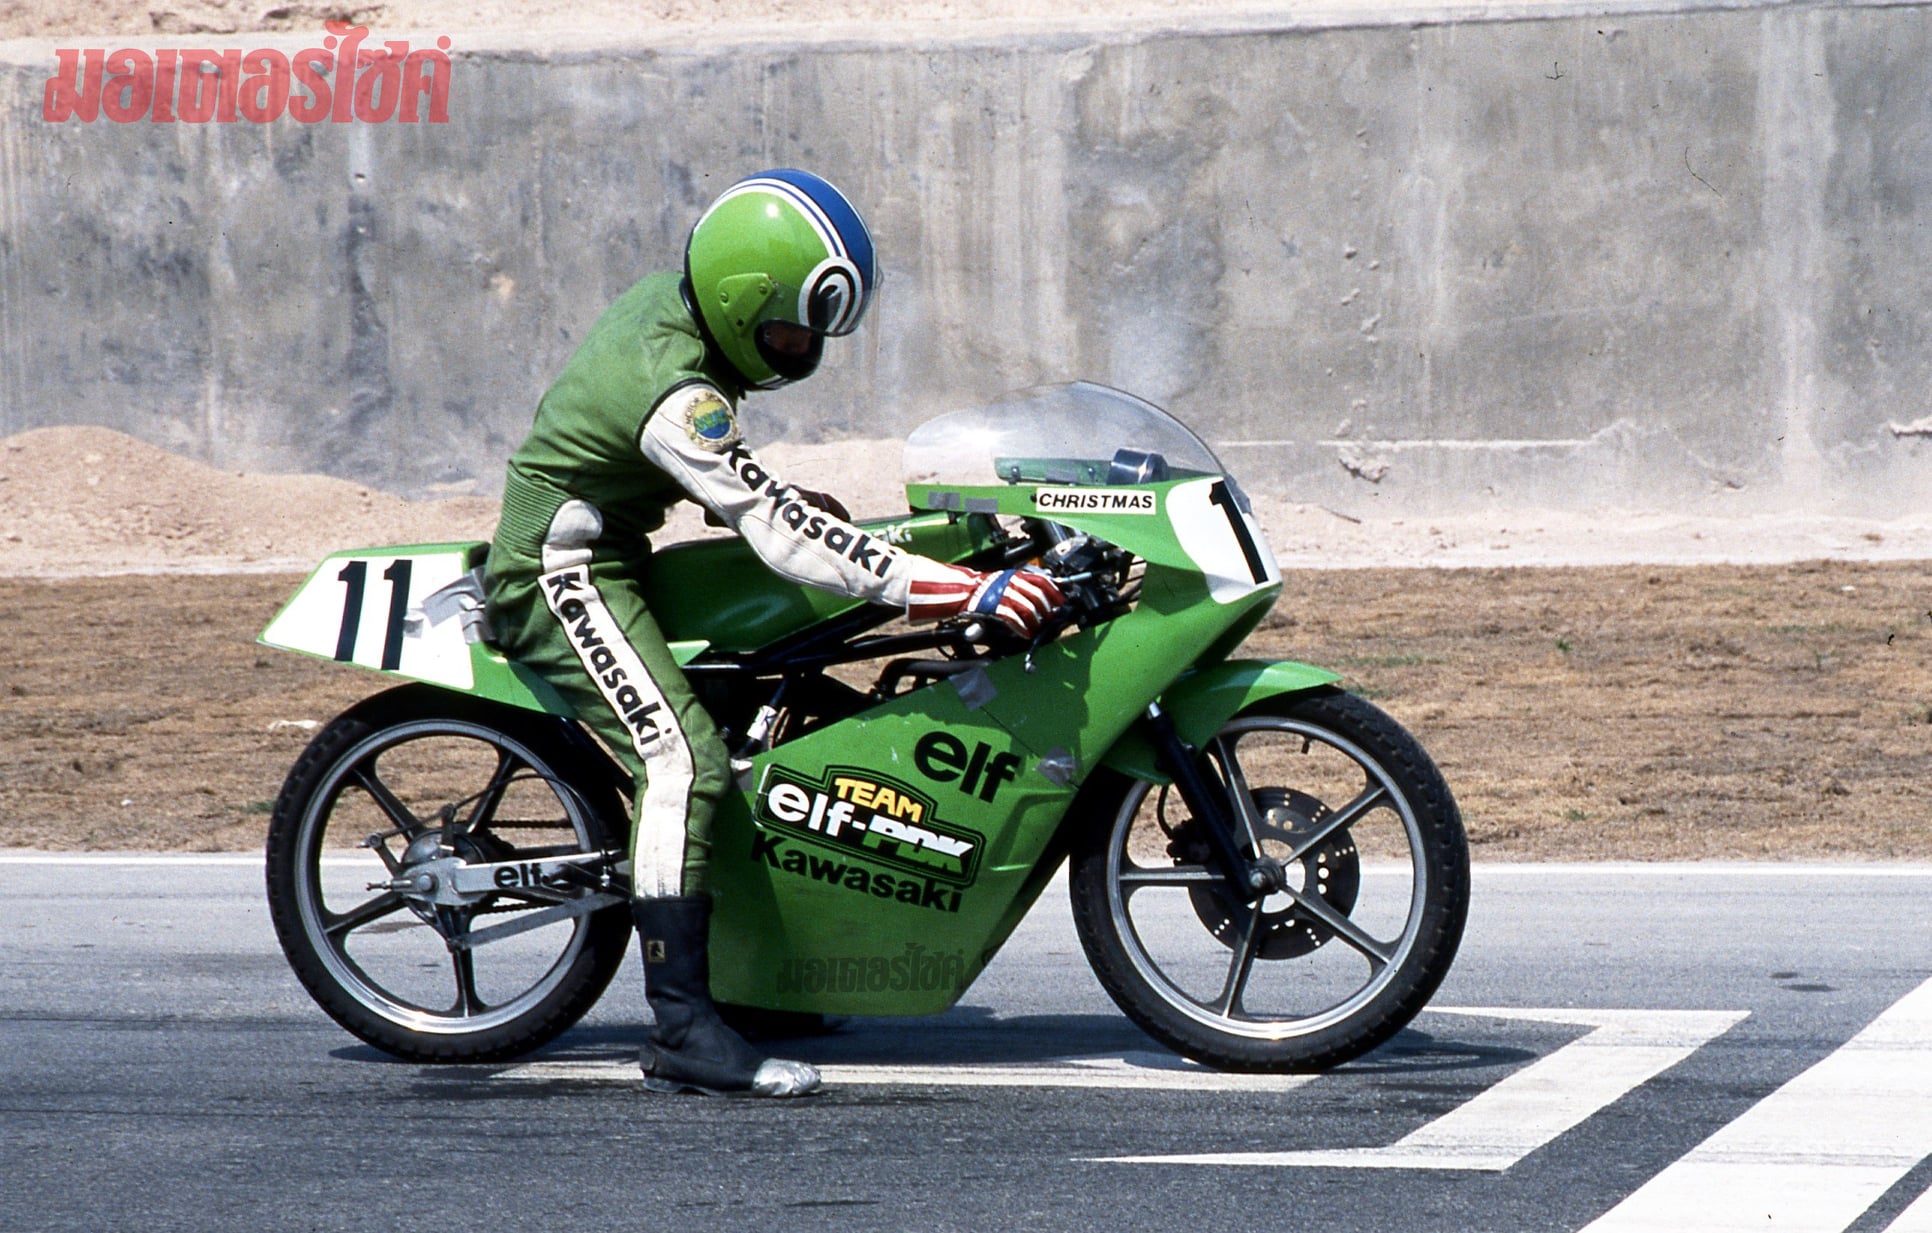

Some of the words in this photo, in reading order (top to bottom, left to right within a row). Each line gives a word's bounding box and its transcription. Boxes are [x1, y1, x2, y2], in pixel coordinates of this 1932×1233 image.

[1038, 492, 1153, 510] CHRISTMAS
[334, 559, 413, 671] 11
[547, 572, 672, 745] Kawasaki
[834, 777, 923, 823] TEAM
[914, 731, 1020, 803] elf
[494, 863, 543, 889] elf
[752, 831, 963, 913] Kawasaki
